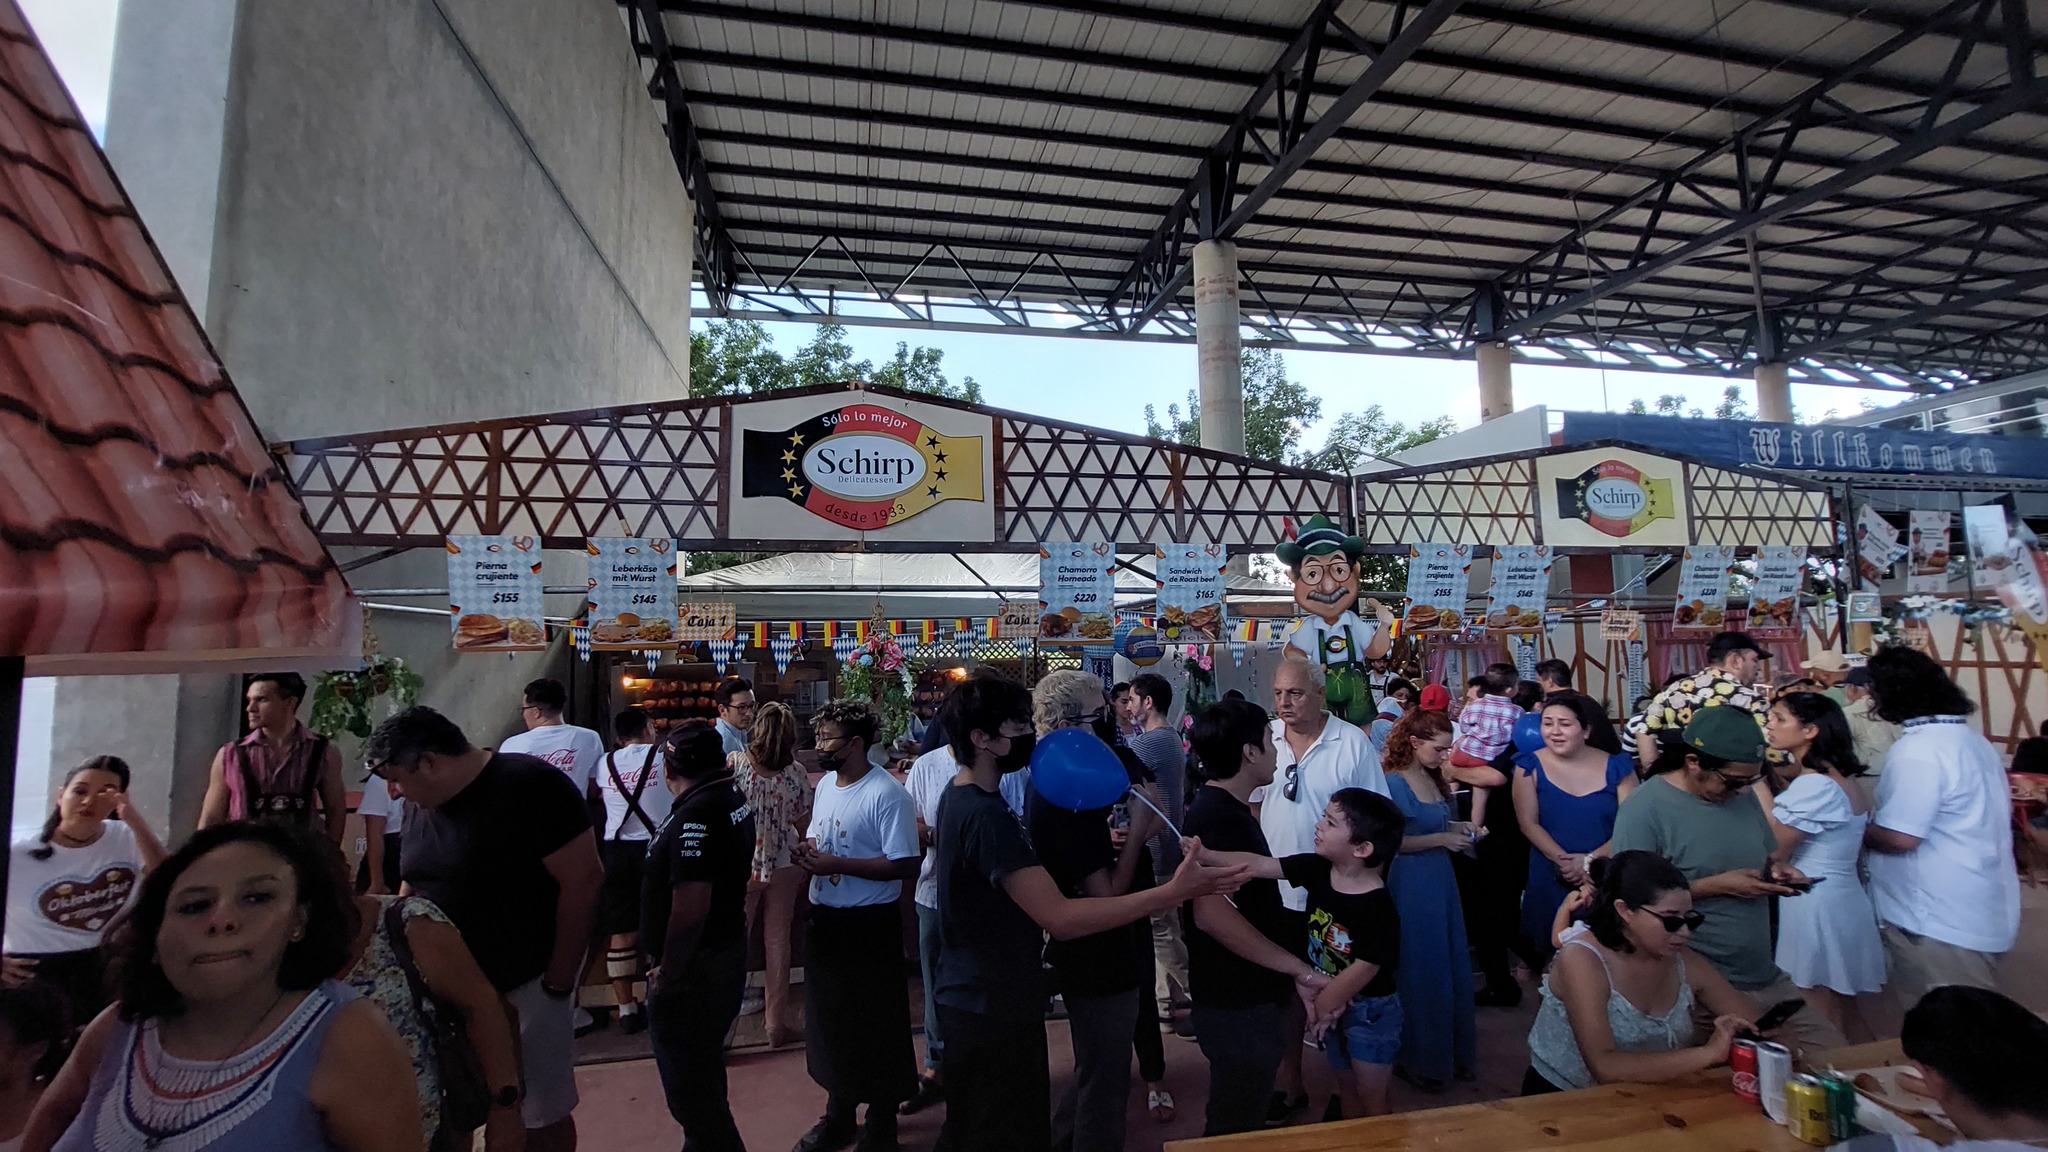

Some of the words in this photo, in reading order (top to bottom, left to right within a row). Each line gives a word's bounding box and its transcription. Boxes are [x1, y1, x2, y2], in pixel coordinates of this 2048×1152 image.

[822, 412, 850, 427] Sólo
[854, 411, 866, 421] lo
[871, 413, 908, 429] mejor
[817, 448, 914, 484] Schirp
[838, 475, 894, 484] Delicatessen
[1592, 487, 1640, 509] Schirp
[825, 503, 867, 523] desde
[872, 503, 906, 522] 1933
[476, 561, 507, 570] Pierna
[612, 564, 658, 572] Leberkäse
[476, 571, 519, 582] crujiente
[630, 574, 656, 582] Wurst
[1426, 572, 1454, 580] crujiente
[1073, 592, 1097, 603] $220
[1195, 590, 1215, 599] $165
[1434, 588, 1452, 597] $155
[1516, 589, 1534, 598] $145
[1701, 588, 1717, 596] $220
[492, 592, 519, 604] $155
[632, 594, 657, 605] $145
[687, 615, 716, 629] Caja
[720, 615, 727, 626] 1
[1005, 614, 1030, 629] Caja
